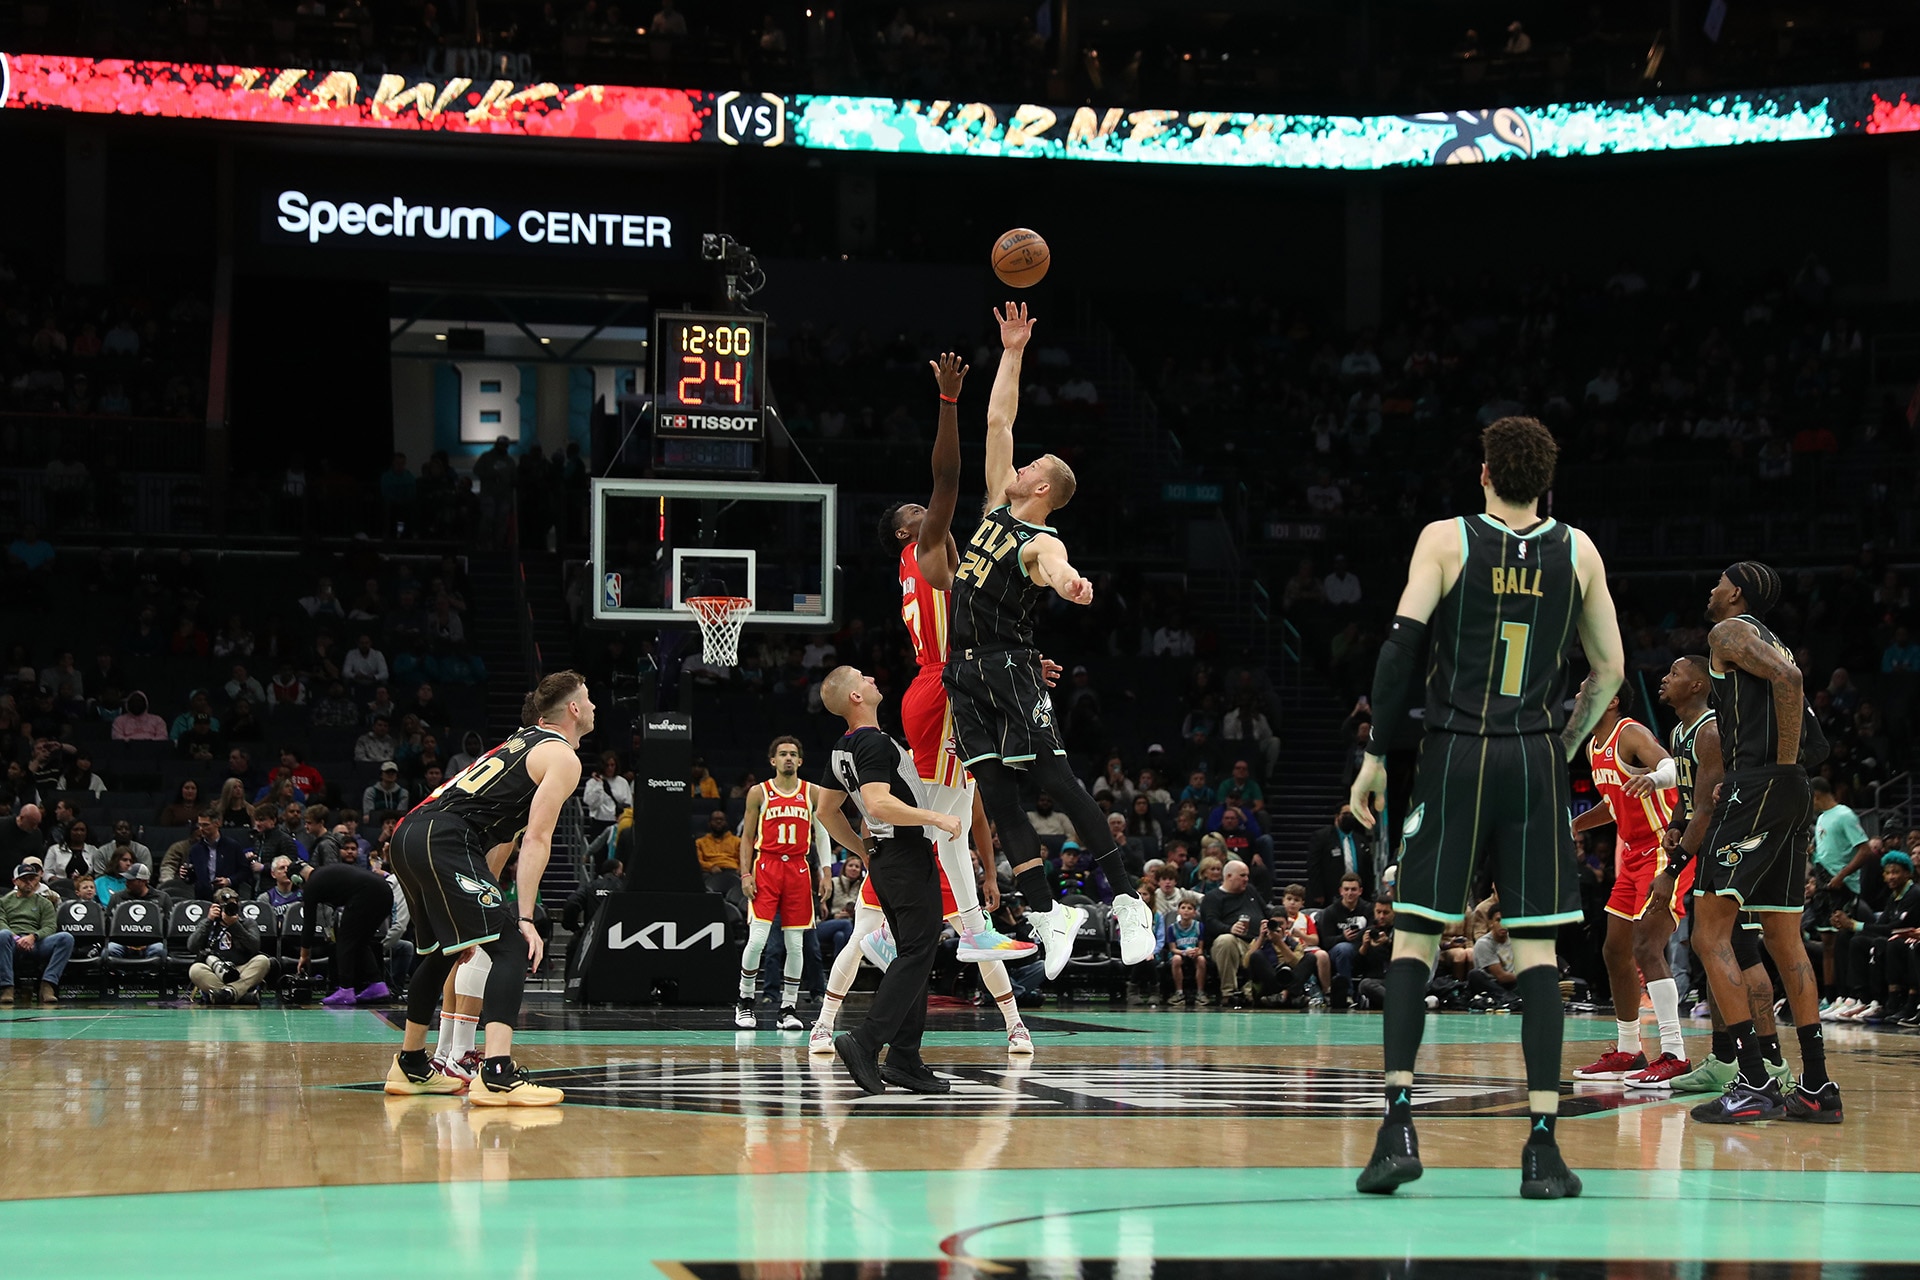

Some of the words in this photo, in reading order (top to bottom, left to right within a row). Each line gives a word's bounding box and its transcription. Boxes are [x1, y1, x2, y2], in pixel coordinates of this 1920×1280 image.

[730, 104, 772, 137] VS
[277, 190, 495, 243] Spectrum
[518, 210, 672, 248] CENTER
[682, 325, 750, 356] 12:00
[678, 356, 741, 405] 24
[688, 416, 758, 431] TISSOT
[970, 518, 1018, 562] CLT
[956, 550, 994, 589] 24
[1492, 567, 1544, 597] BALL
[1500, 621, 1530, 697] 1
[765, 806, 809, 822] ATLANTA
[777, 823, 797, 845] 11
[61, 924, 95, 932] wave
[120, 924, 153, 933] wave
[608, 921, 726, 951] KIA
